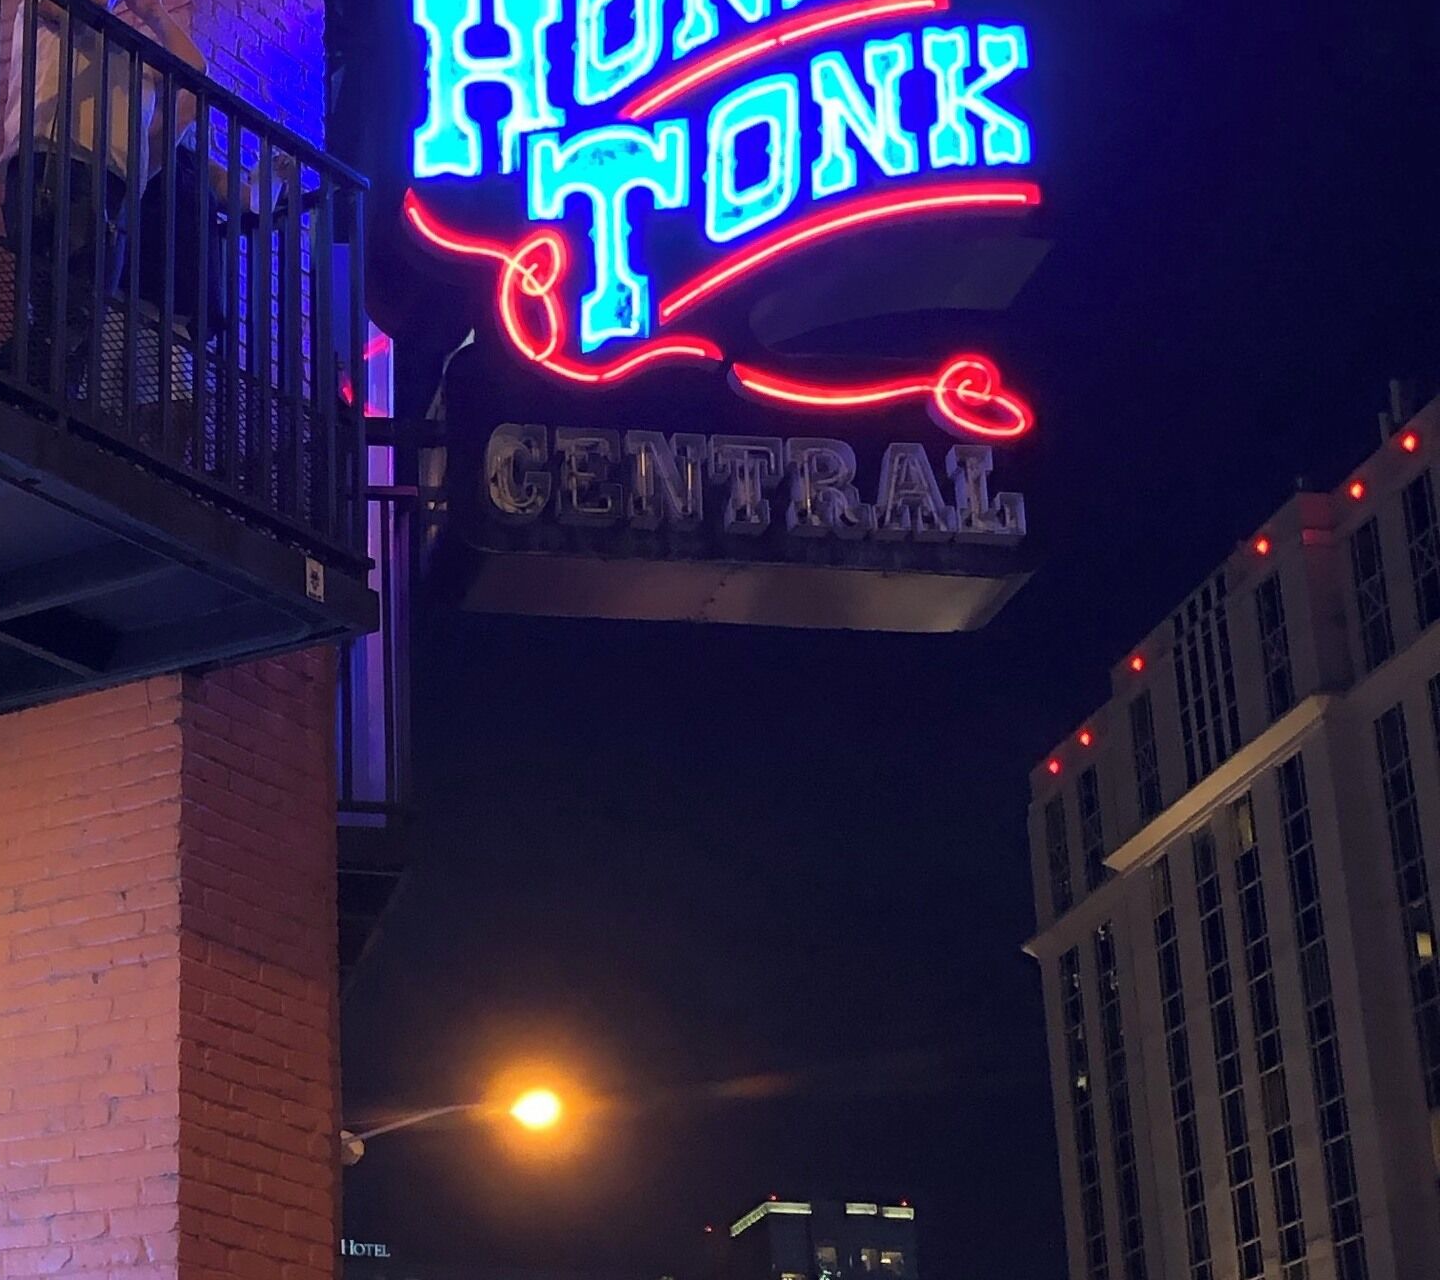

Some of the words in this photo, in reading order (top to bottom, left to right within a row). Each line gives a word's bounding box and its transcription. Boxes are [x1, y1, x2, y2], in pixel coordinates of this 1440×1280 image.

[526, 24, 1031, 353] TONK
[486, 422, 1027, 540] CENTRAL
[341, 1238, 391, 1258] HOTEL
